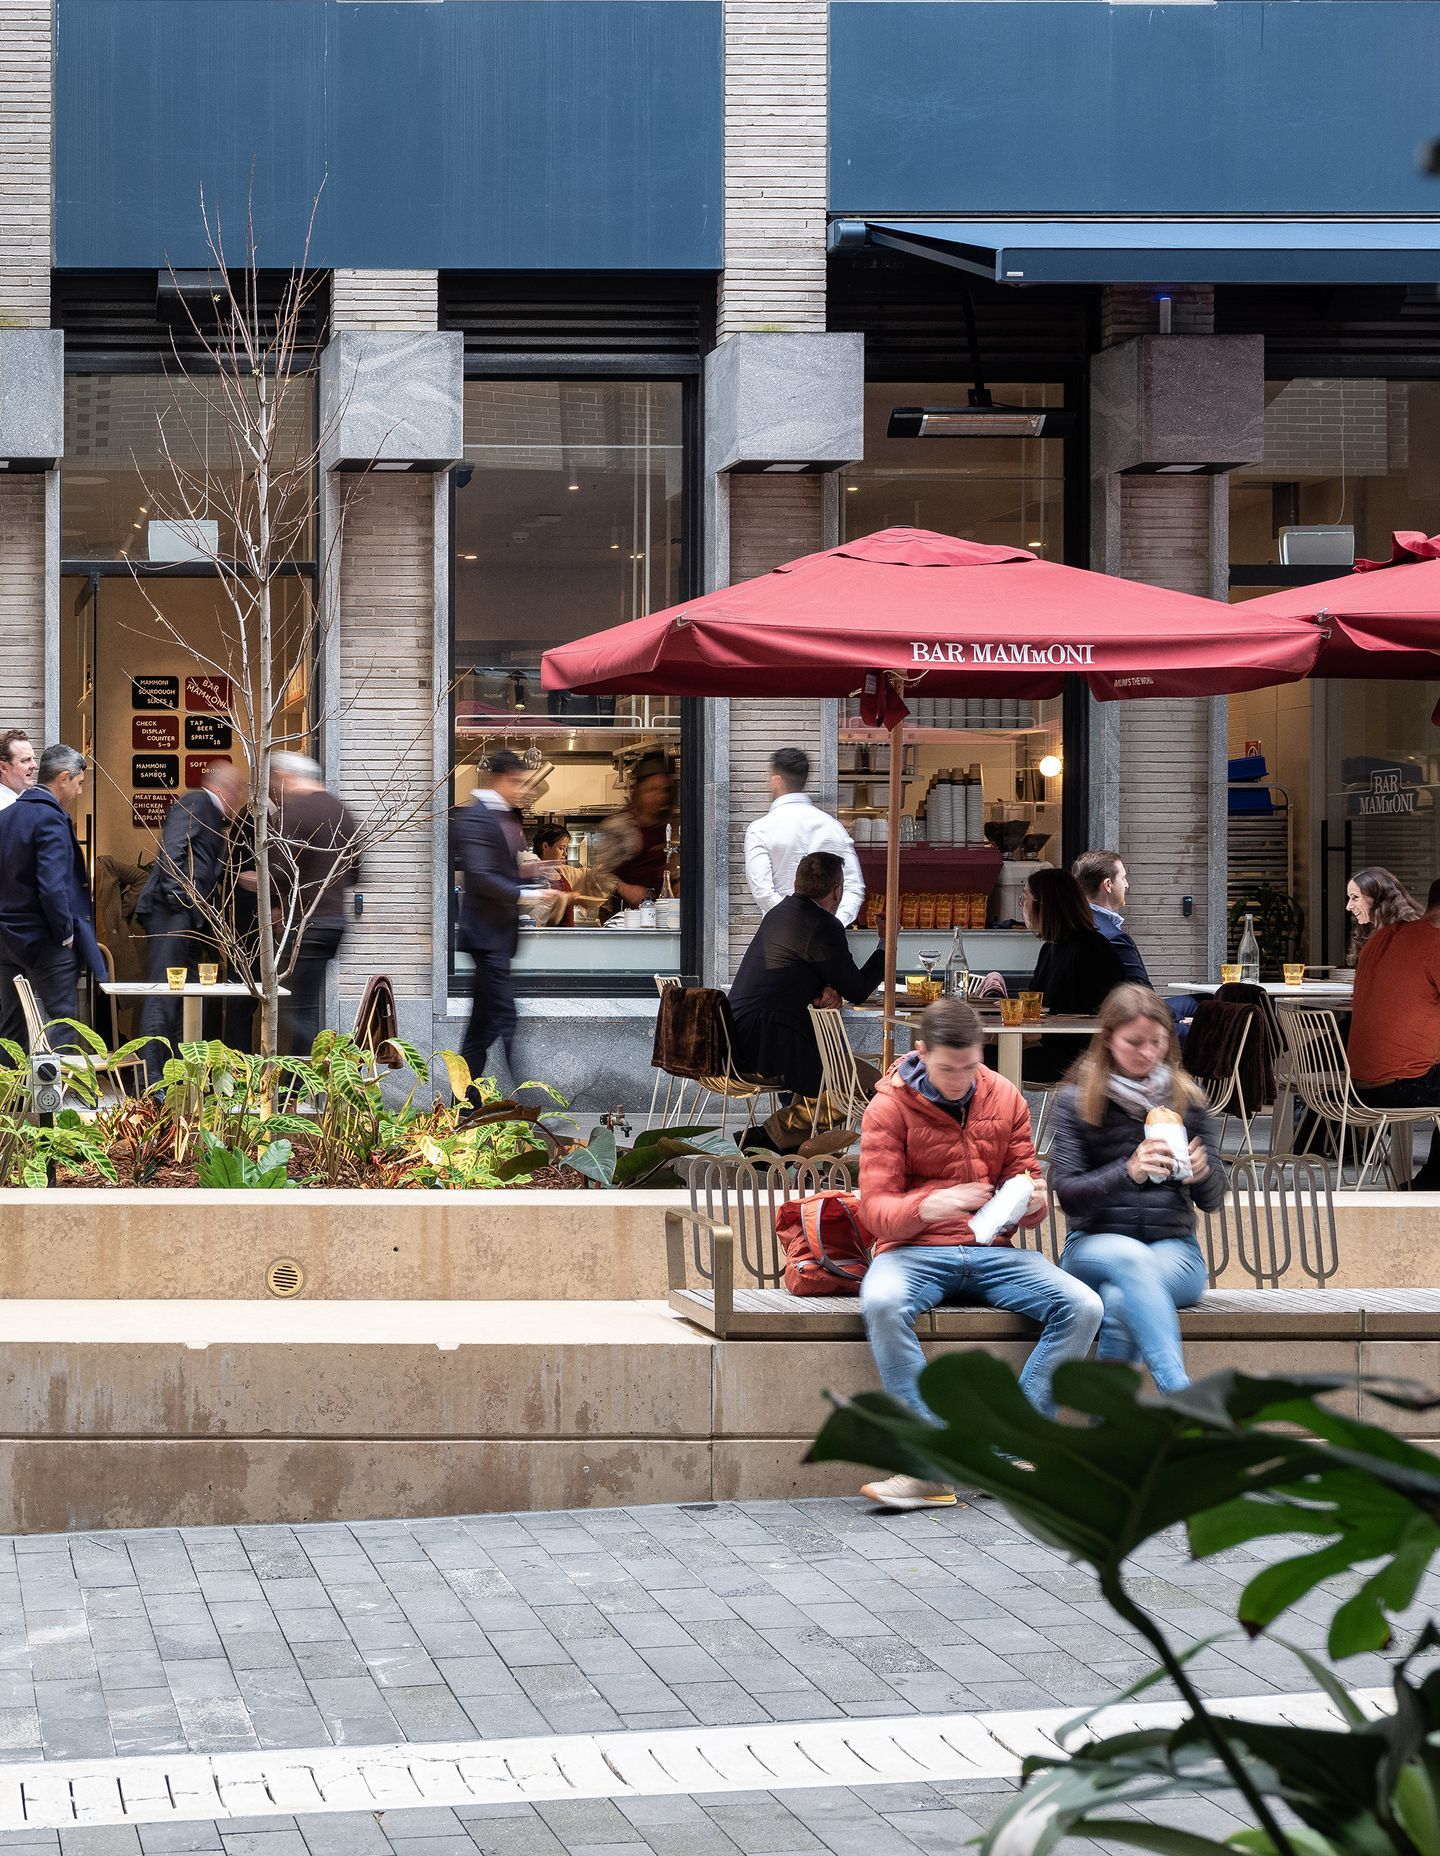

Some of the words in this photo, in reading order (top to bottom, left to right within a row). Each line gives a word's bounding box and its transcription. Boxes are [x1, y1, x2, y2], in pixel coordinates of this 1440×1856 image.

[910, 642, 965, 663] BAR
[202, 679, 220, 692] BAR
[1374, 774, 1399, 795] BAR
